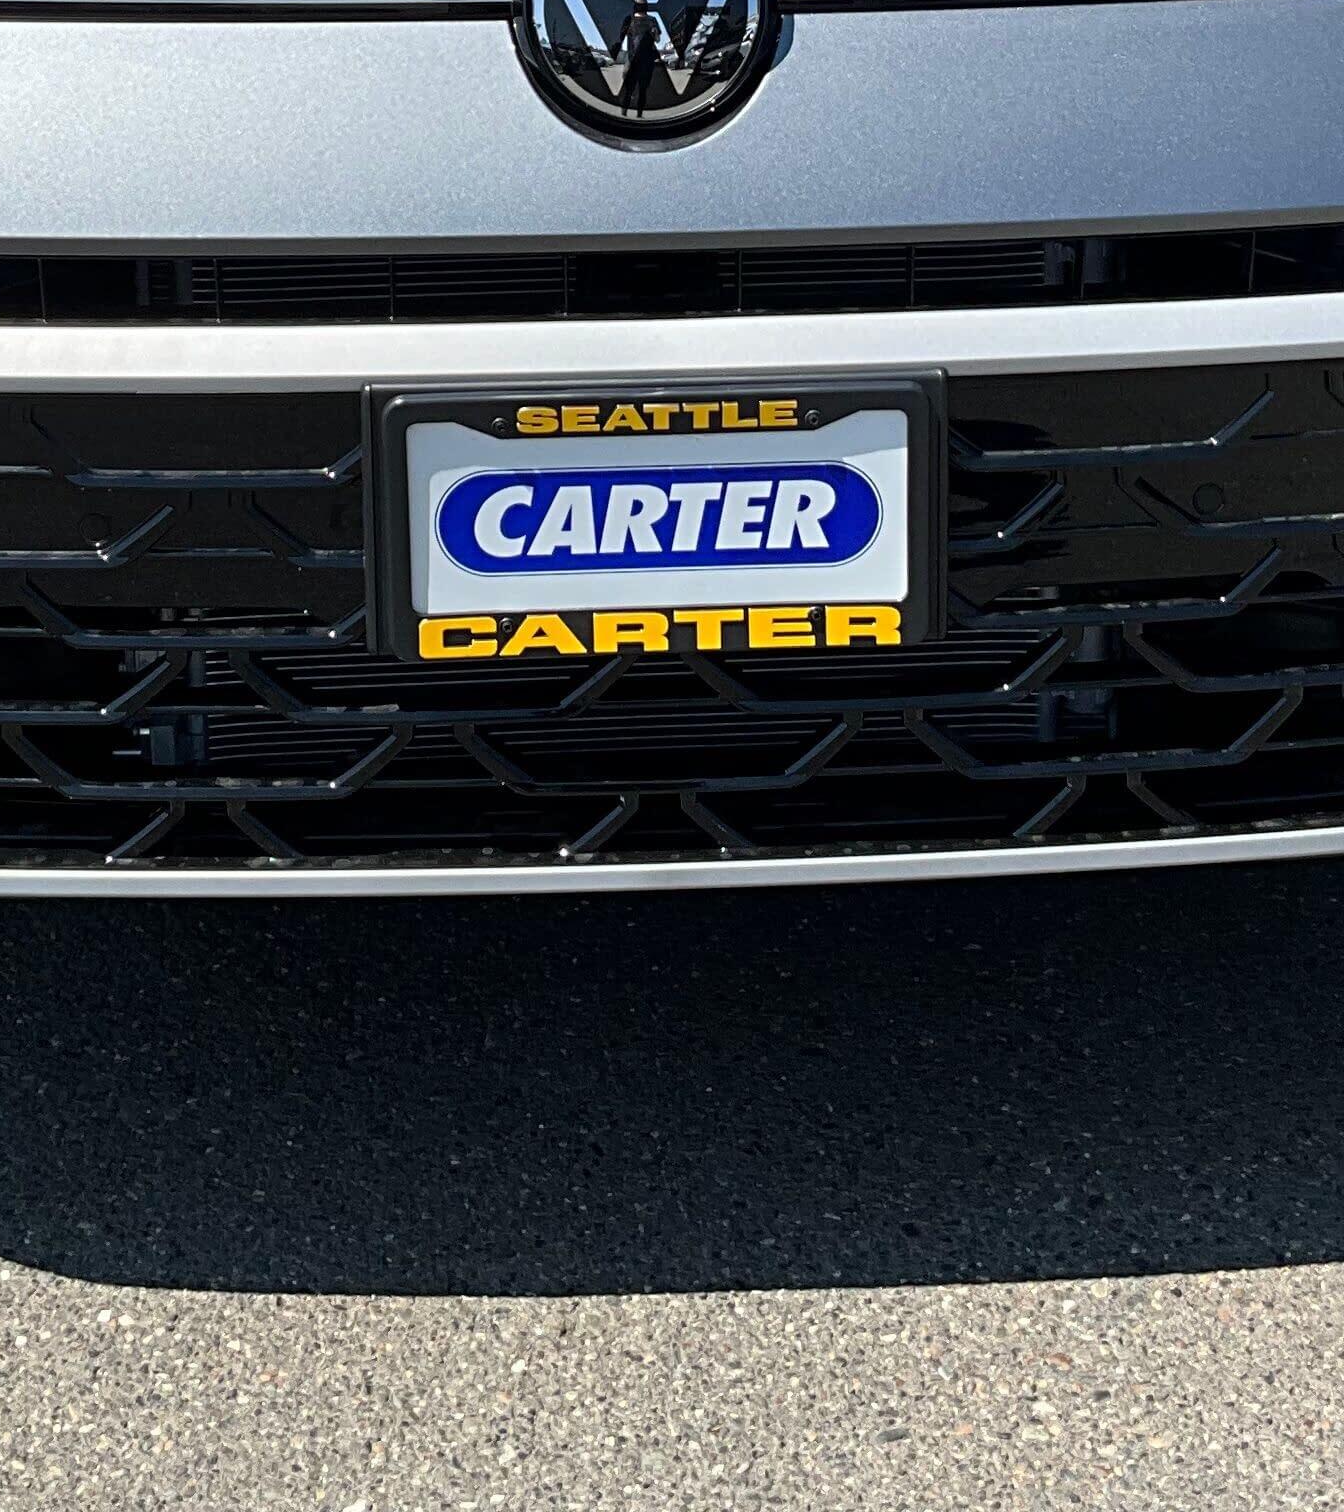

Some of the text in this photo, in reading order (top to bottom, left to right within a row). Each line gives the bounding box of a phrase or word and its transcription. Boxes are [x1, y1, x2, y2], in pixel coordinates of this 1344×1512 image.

[515, 399, 799, 434] SEATTLE
[473, 479, 837, 558] CARTER
[418, 605, 903, 660] CARTER
